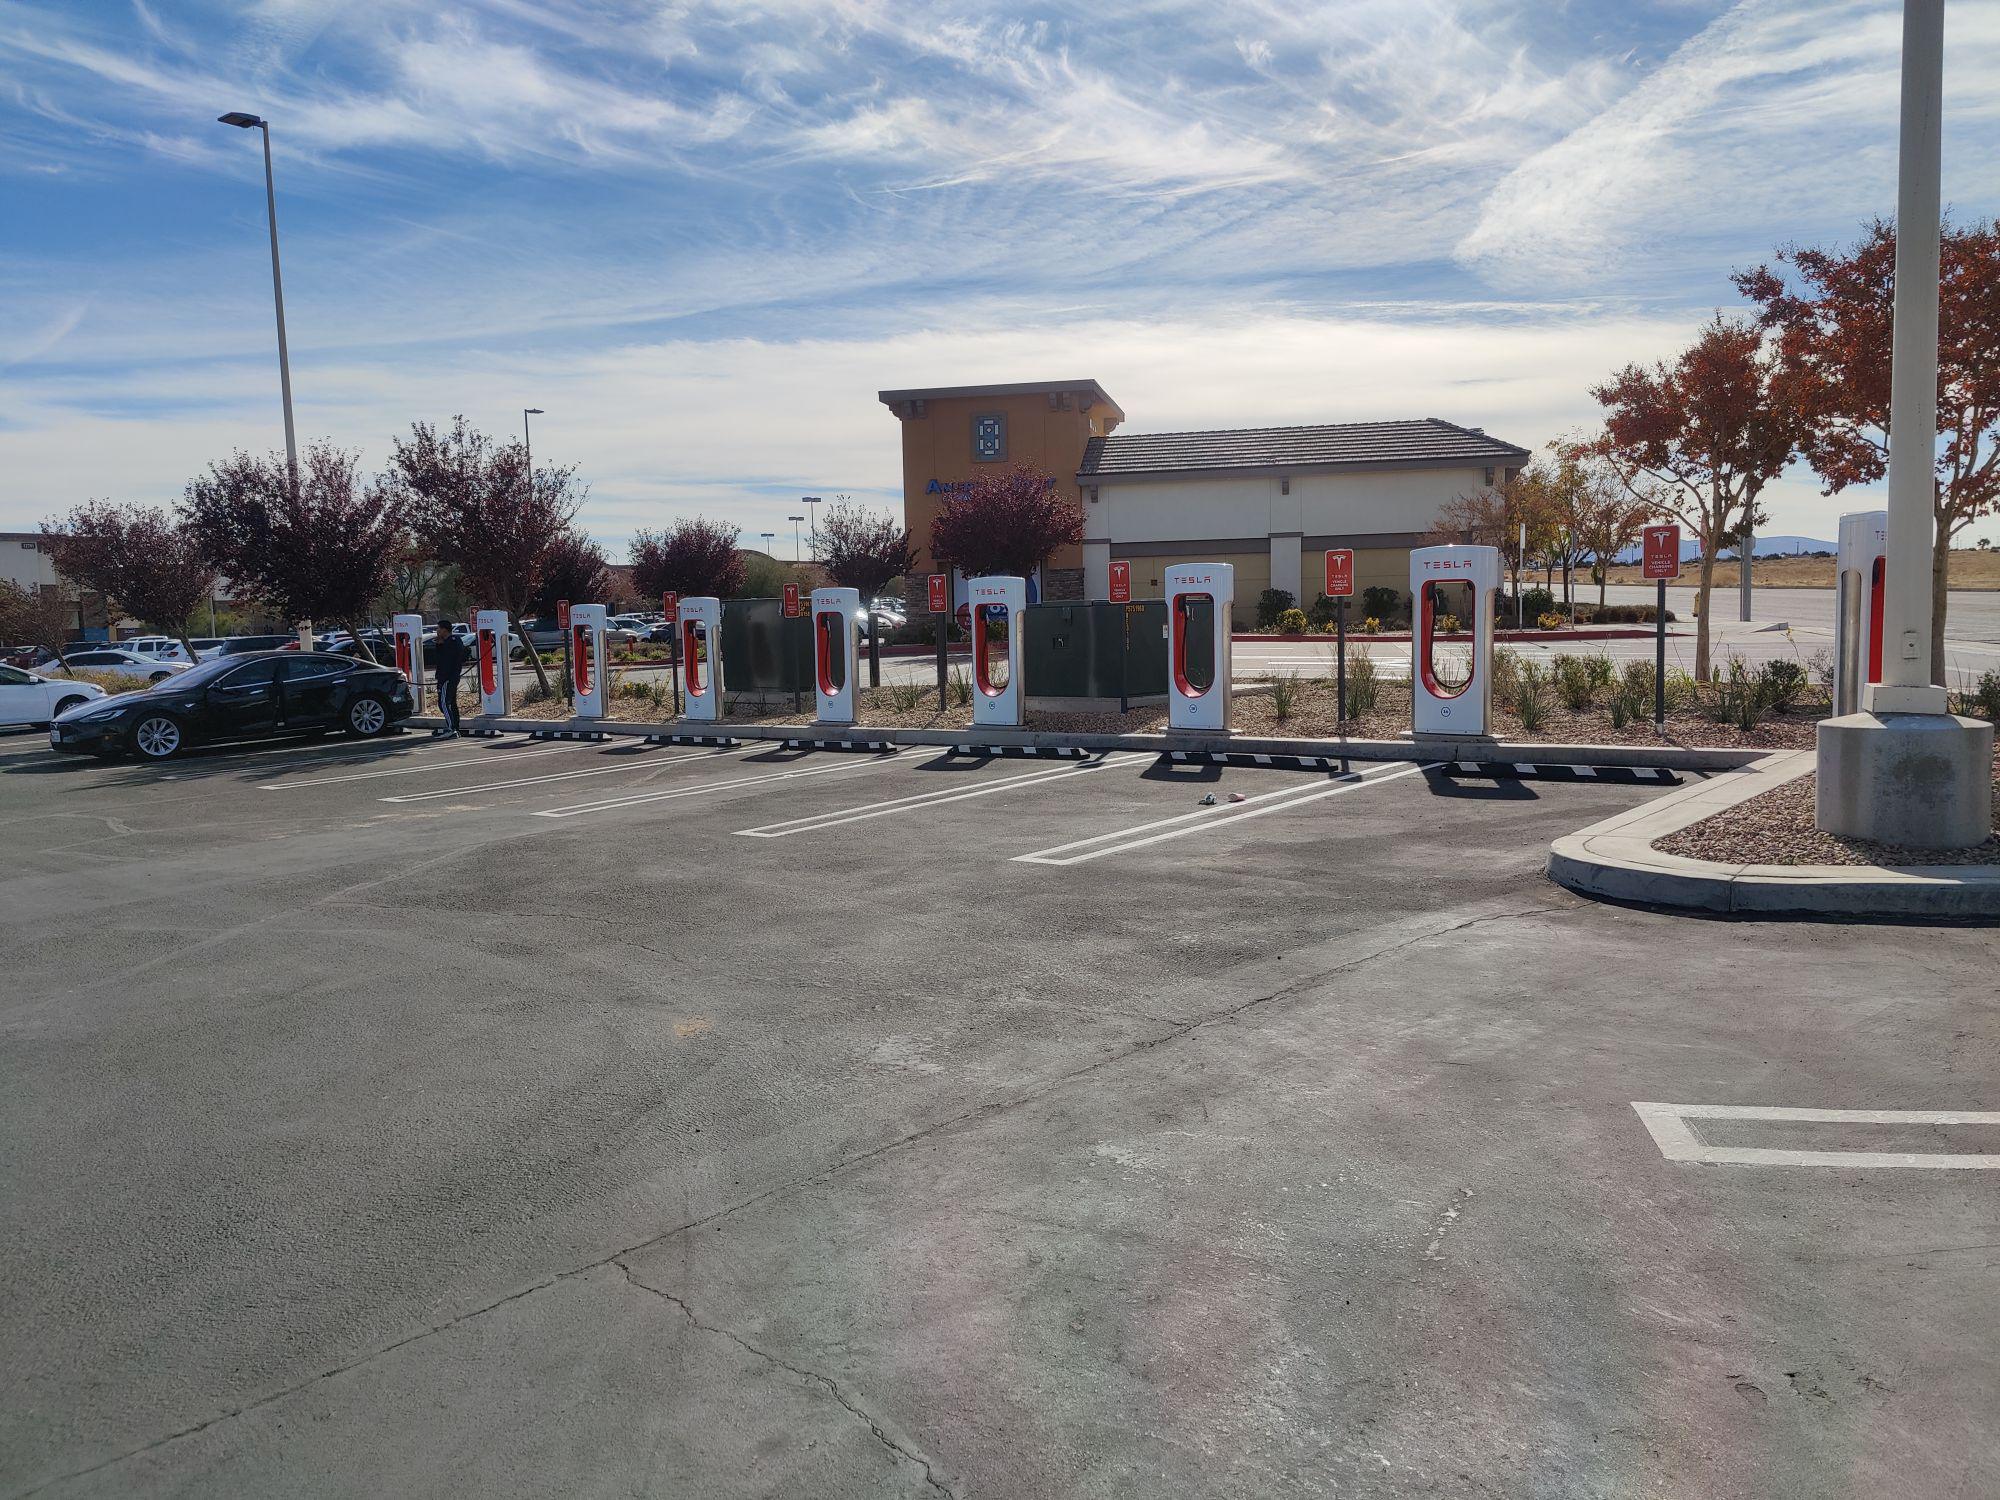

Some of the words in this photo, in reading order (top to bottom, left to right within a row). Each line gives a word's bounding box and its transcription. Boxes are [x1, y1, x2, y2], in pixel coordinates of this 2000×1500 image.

[1424, 560, 1472, 569] TESLA
[1174, 576, 1211, 584] TESLA
[975, 588, 1006, 596] TESLA
